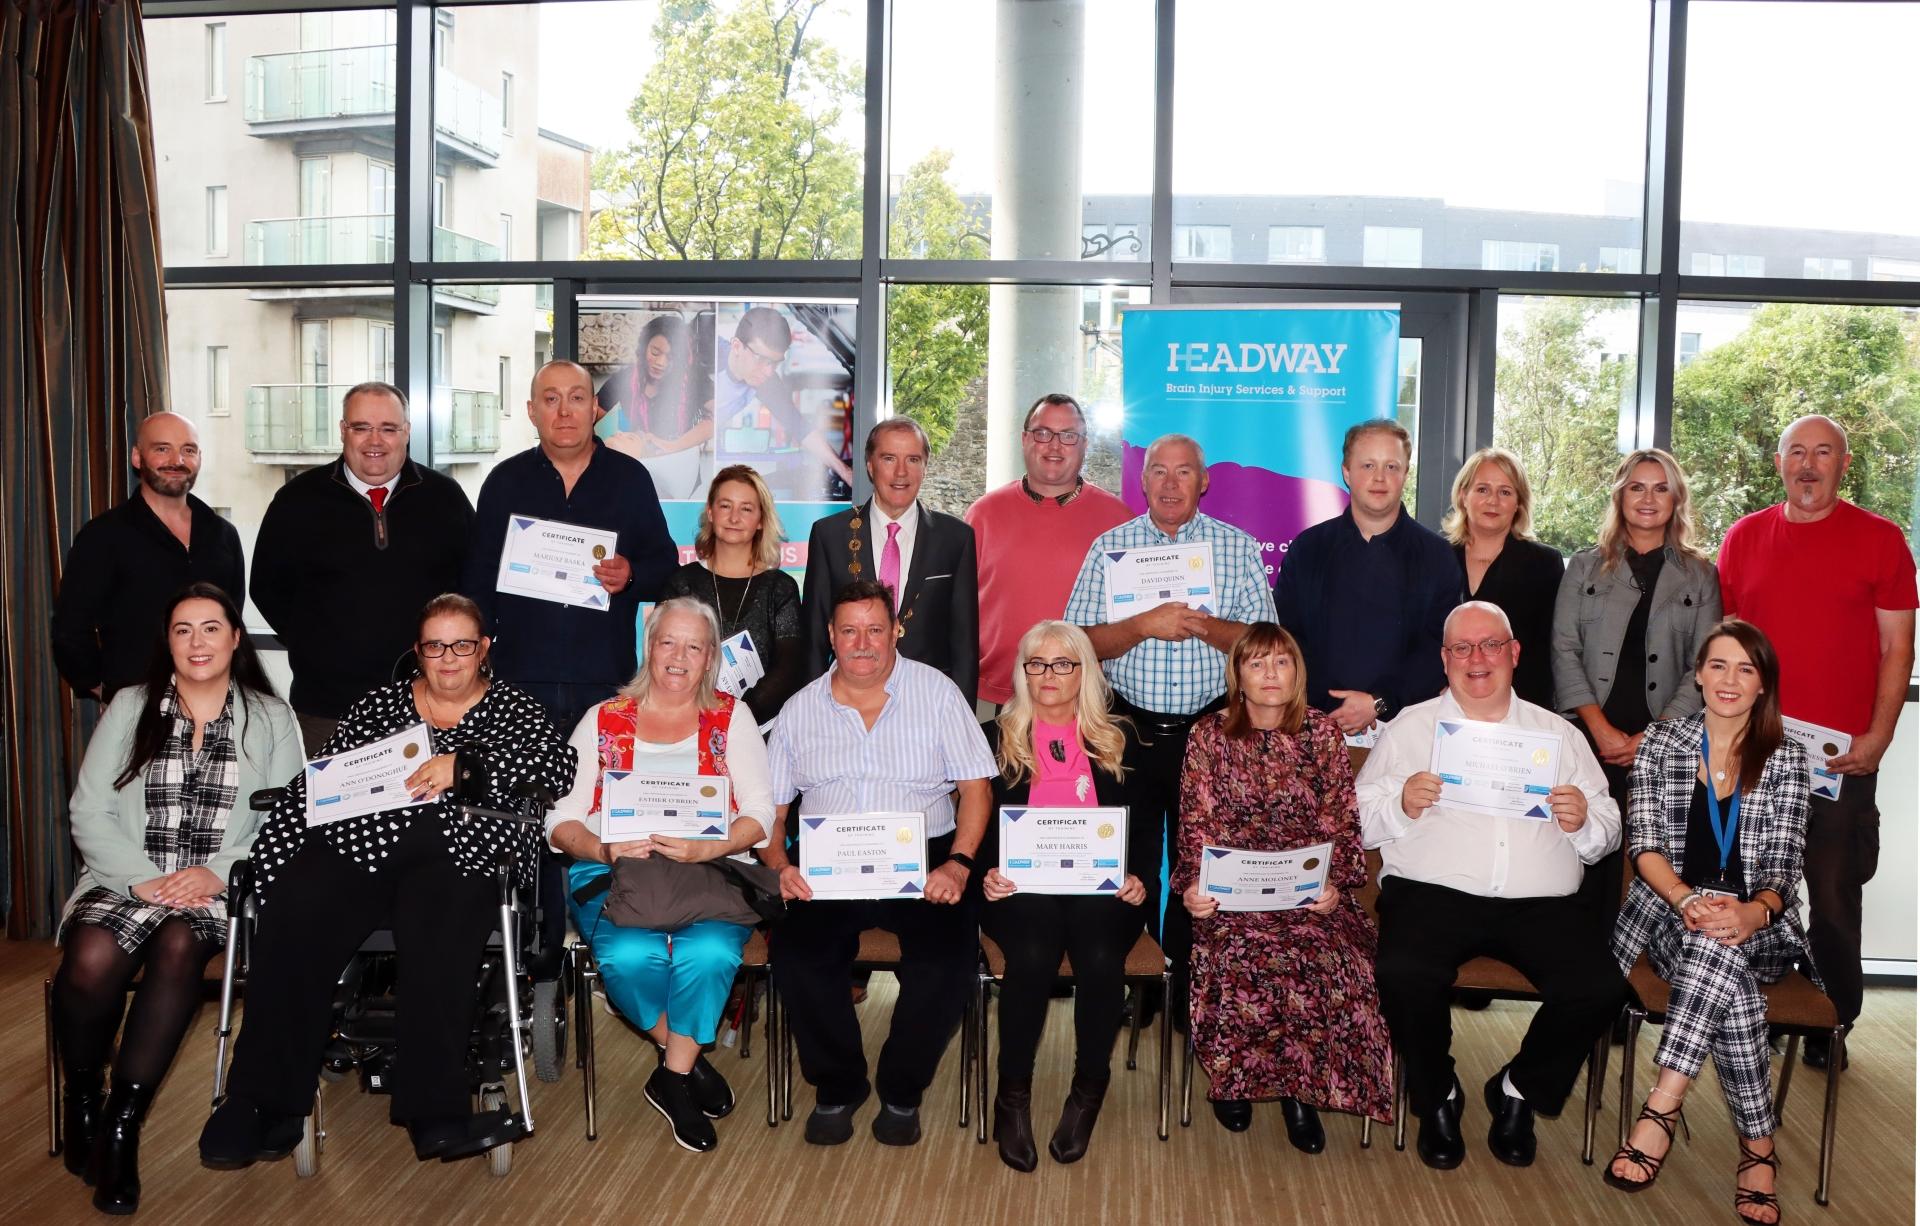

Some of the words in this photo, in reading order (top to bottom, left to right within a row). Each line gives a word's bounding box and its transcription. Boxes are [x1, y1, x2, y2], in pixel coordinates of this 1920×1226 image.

[1167, 343, 1347, 374] HEADWAY
[1166, 384, 1195, 393] Brain
[1199, 384, 1232, 396] Injury
[1236, 385, 1284, 395] Services
[1287, 386, 1296, 394] &
[1299, 386, 1346, 398] Support
[542, 531, 585, 544] CERTIFICATE
[1136, 554, 1180, 564] CERTIFICATE
[1141, 576, 1162, 584] DAVID
[1163, 575, 1185, 584] QUINN
[1784, 726, 1815, 740] TIFICATE
[344, 748, 393, 768] CERTIFICATE
[340, 780, 356, 788] ANN
